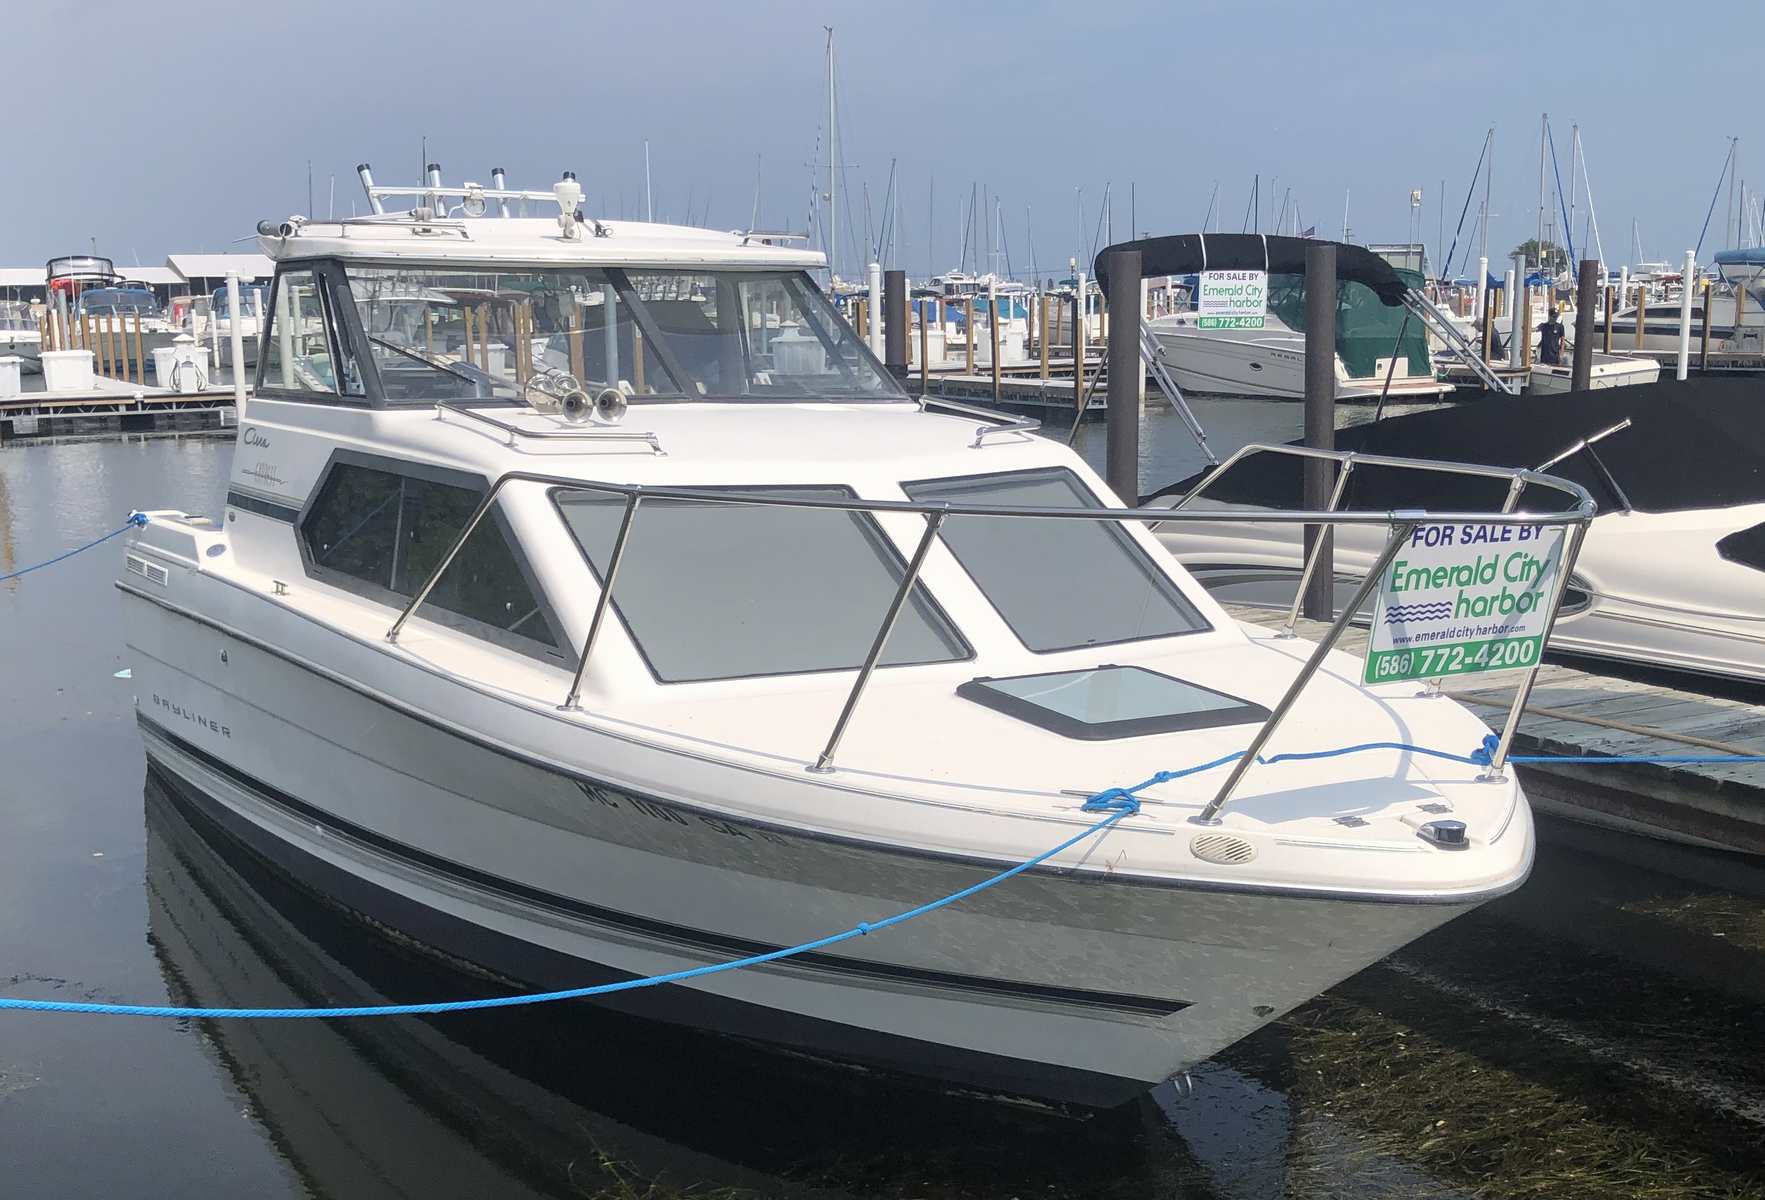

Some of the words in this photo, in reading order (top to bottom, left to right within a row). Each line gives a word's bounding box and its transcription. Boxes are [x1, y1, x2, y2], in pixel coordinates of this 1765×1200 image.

[1208, 272, 1225, 281] FOR
[1226, 272, 1247, 281] SALE
[1249, 272, 1259, 281] BY
[1203, 284, 1243, 296] Emerald
[1245, 284, 1263, 297] City
[1229, 297, 1263, 308] harbor
[1219, 317, 1263, 328] 772-4200
[1411, 525, 1455, 548] FOR
[1460, 524, 1513, 545] SALE
[1518, 525, 1544, 541] BY
[1390, 554, 1499, 593] Emerald
[1503, 551, 1551, 589] City
[1453, 586, 1544, 619] harbor
[1375, 651, 1415, 679] (586)
[1419, 639, 1535, 675] 772-4200
